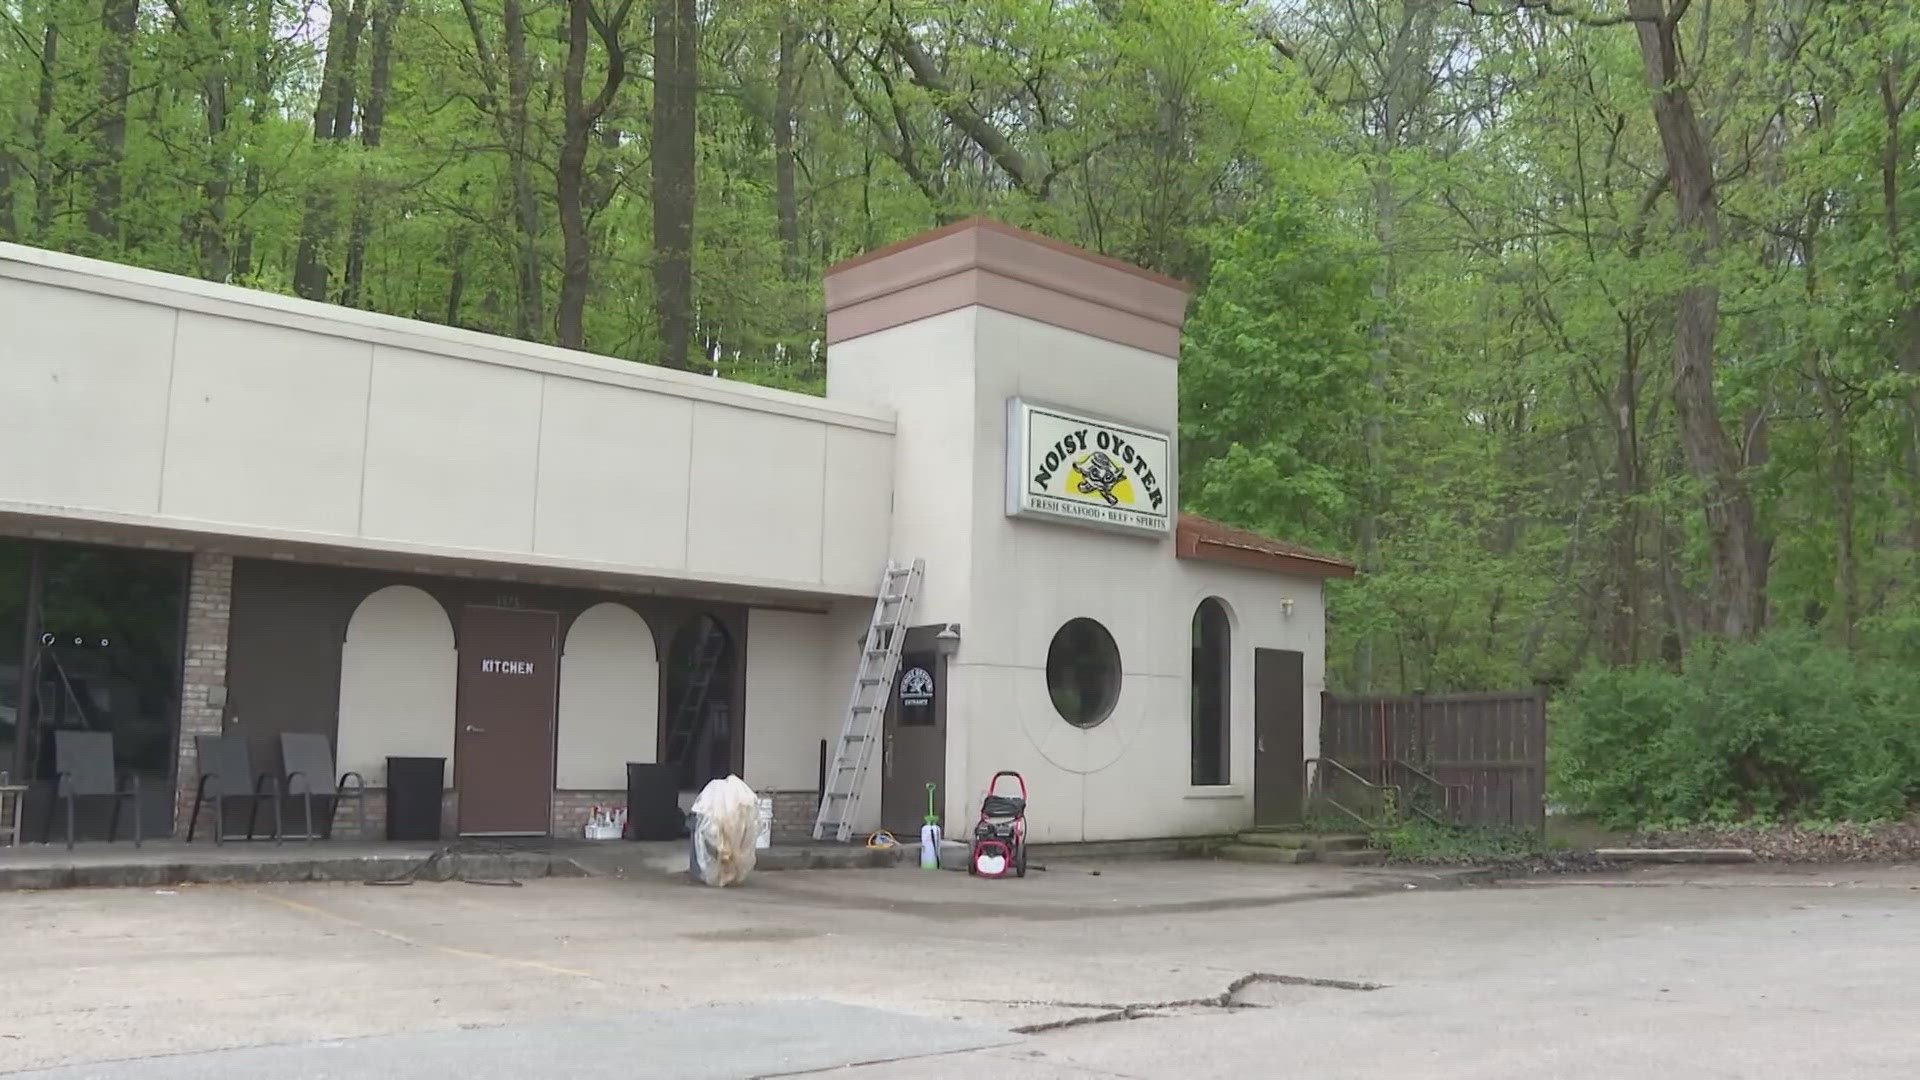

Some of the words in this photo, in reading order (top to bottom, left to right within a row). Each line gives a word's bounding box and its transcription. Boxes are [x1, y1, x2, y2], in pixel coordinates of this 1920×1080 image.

[1034, 429, 1088, 490] NOISY
[1096, 431, 1163, 510] OYSTER
[1030, 498, 1060, 512] FRESH
[1061, 505, 1100, 519] SEAFOOD
[1108, 511, 1129, 523] BEEF
[1136, 515, 1166, 530] SPIRITS
[482, 659, 534, 675] KITCHEN
